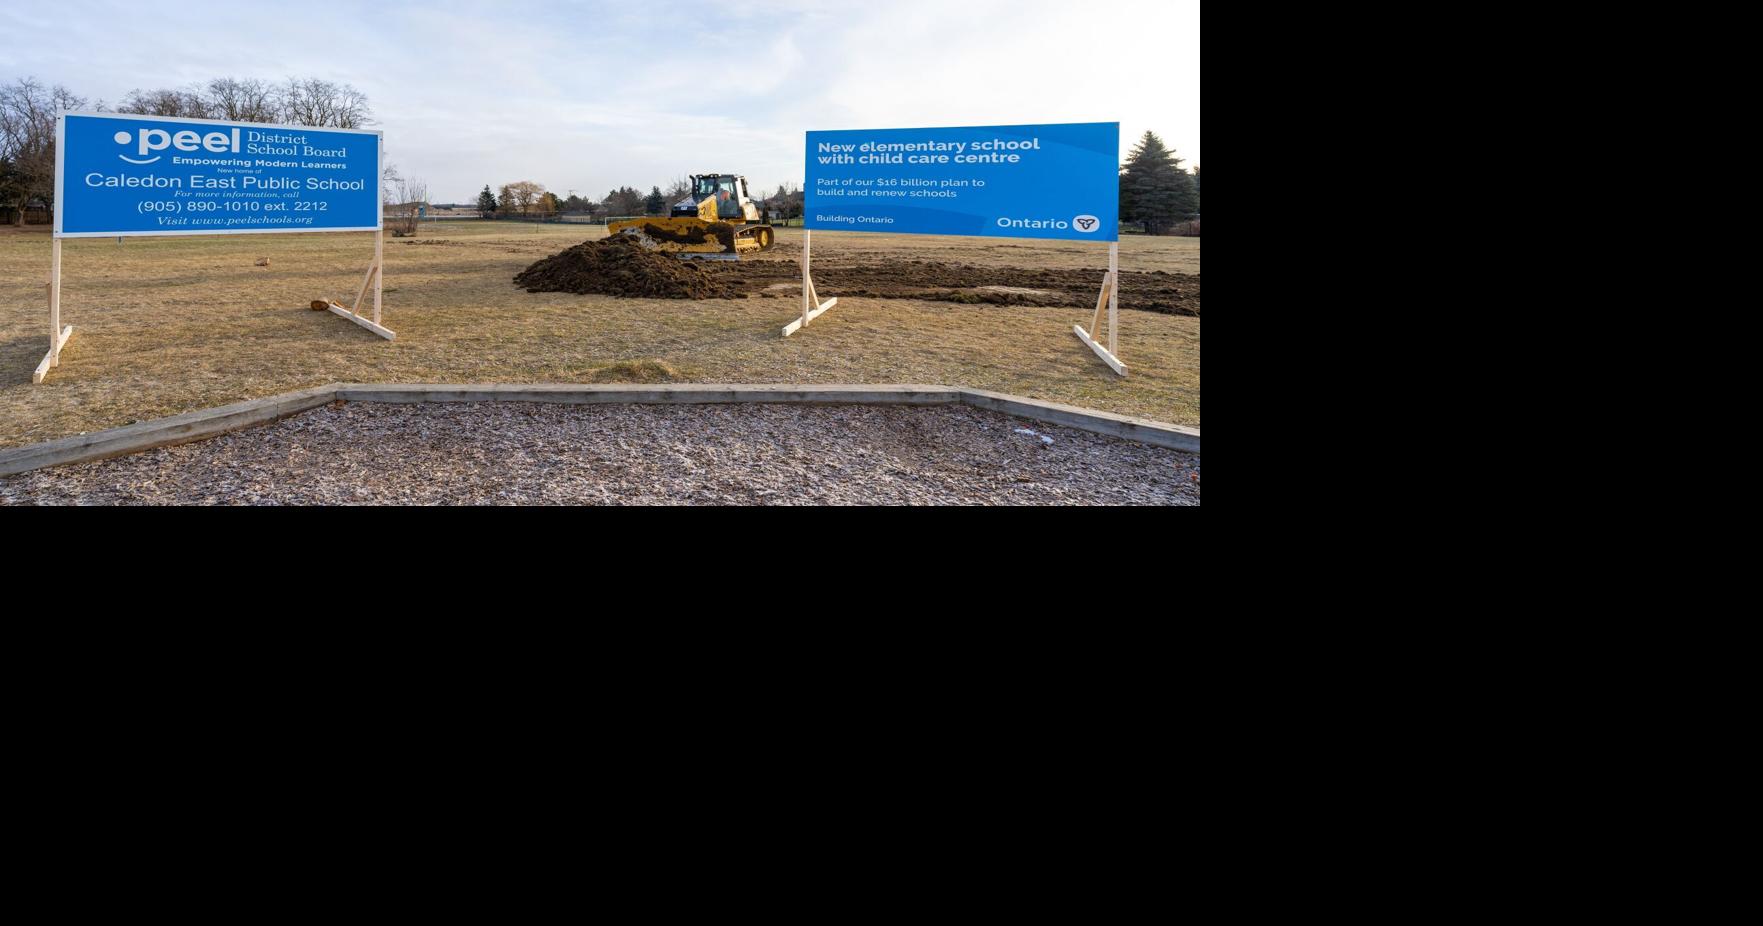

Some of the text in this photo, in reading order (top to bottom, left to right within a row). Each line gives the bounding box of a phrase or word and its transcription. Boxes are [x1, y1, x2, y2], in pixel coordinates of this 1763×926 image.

[138, 127, 241, 156] peel
[247, 130, 308, 145] District
[247, 143, 346, 158] School Board
[818, 137, 1041, 154] New elementary school
[172, 156, 347, 169] Empowering Modern Learners
[818, 151, 1021, 164] with child care centre
[85, 172, 364, 191] Caledon East Public School
[817, 178, 839, 186] Part
[841, 177, 854, 186] of
[877, 178, 898, 187] $16
[900, 178, 938, 187] billion
[940, 178, 969, 189] plan
[972, 178, 986, 187] to
[174, 190, 193, 198] For
[222, 190, 281, 199] information,
[282, 191, 300, 199] call
[816, 188, 845, 196] build
[847, 188, 869, 197] and
[909, 189, 958, 198] schools
[137, 200, 328, 214] (905) 890-1010 ext. 2212
[158, 215, 313, 226] Visit www.peelschools.org
[816, 214, 894, 225] Building Ontario
[996, 217, 1069, 230] Ontario
